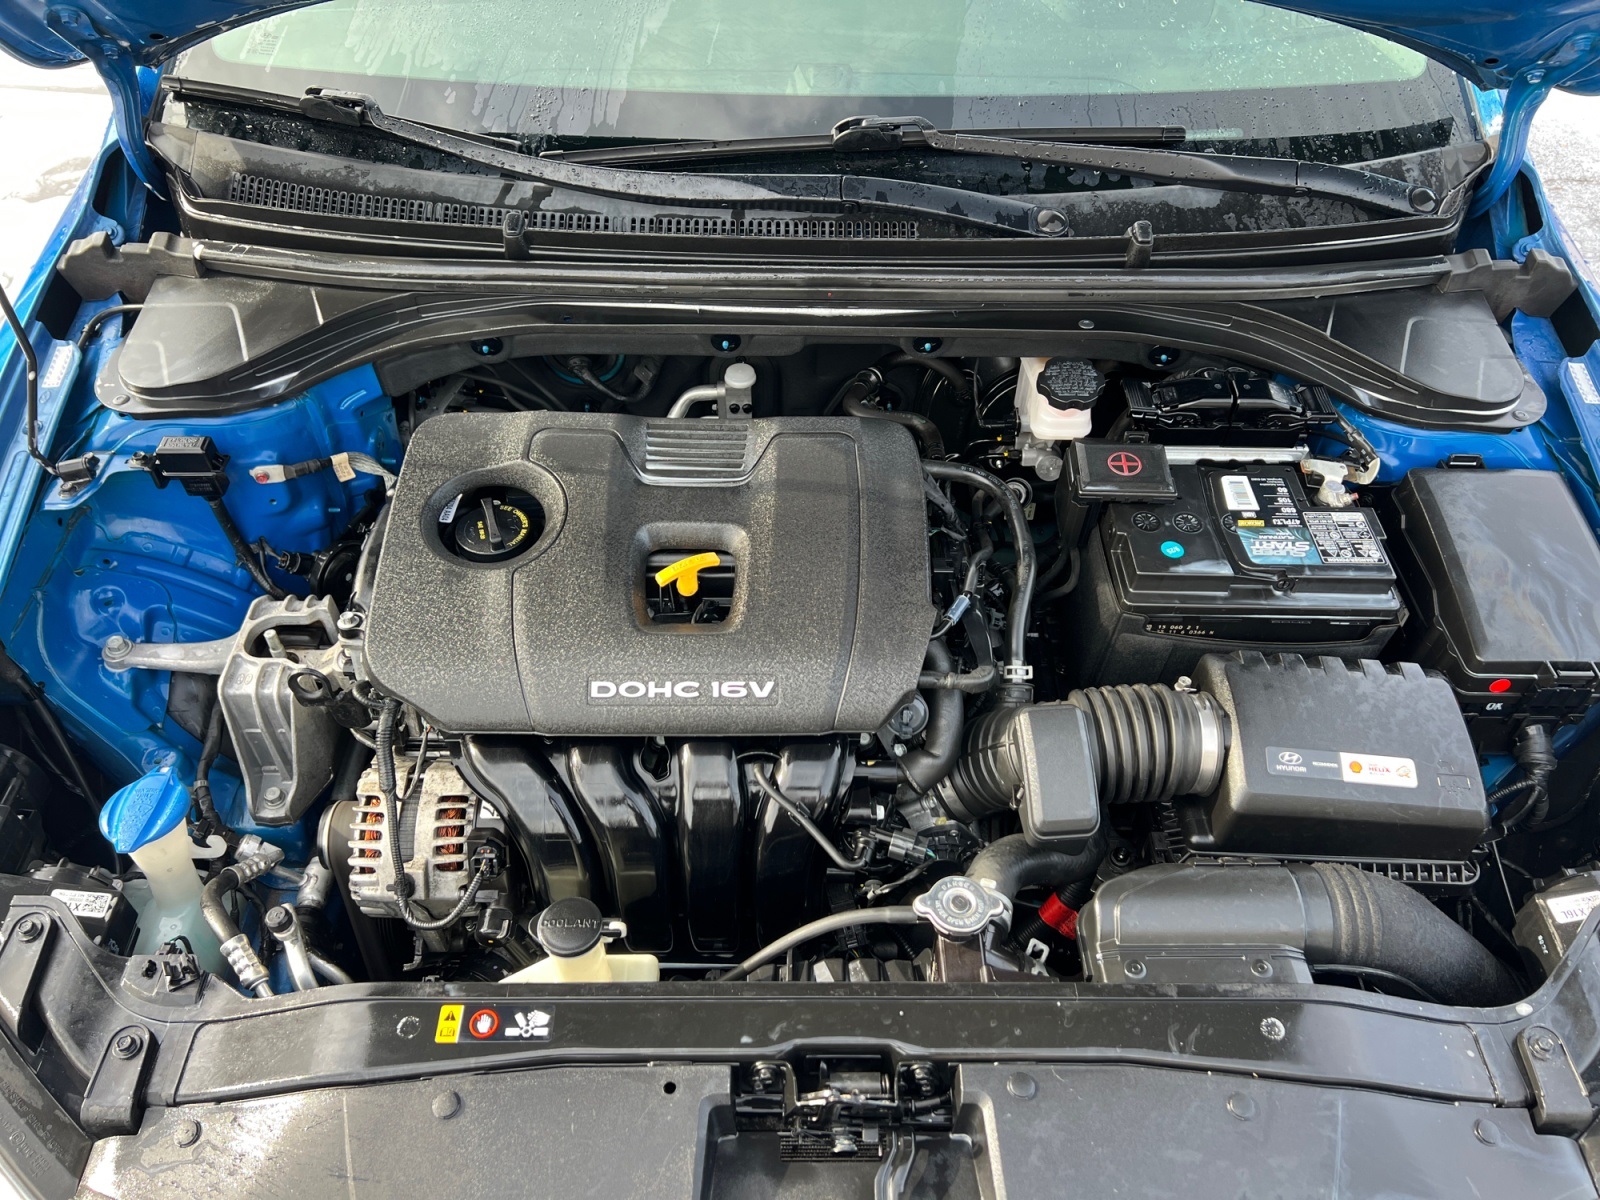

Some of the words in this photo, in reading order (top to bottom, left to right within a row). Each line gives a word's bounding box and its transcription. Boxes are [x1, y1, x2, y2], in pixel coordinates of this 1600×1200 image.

[1250, 541, 1310, 551] START
[1252, 548, 1307, 558] SUPER
[591, 681, 700, 698] DOHC
[711, 681, 775, 698] 16V
[1276, 764, 1307, 773] HYUNDAI
[542, 918, 600, 929] COOLANT
